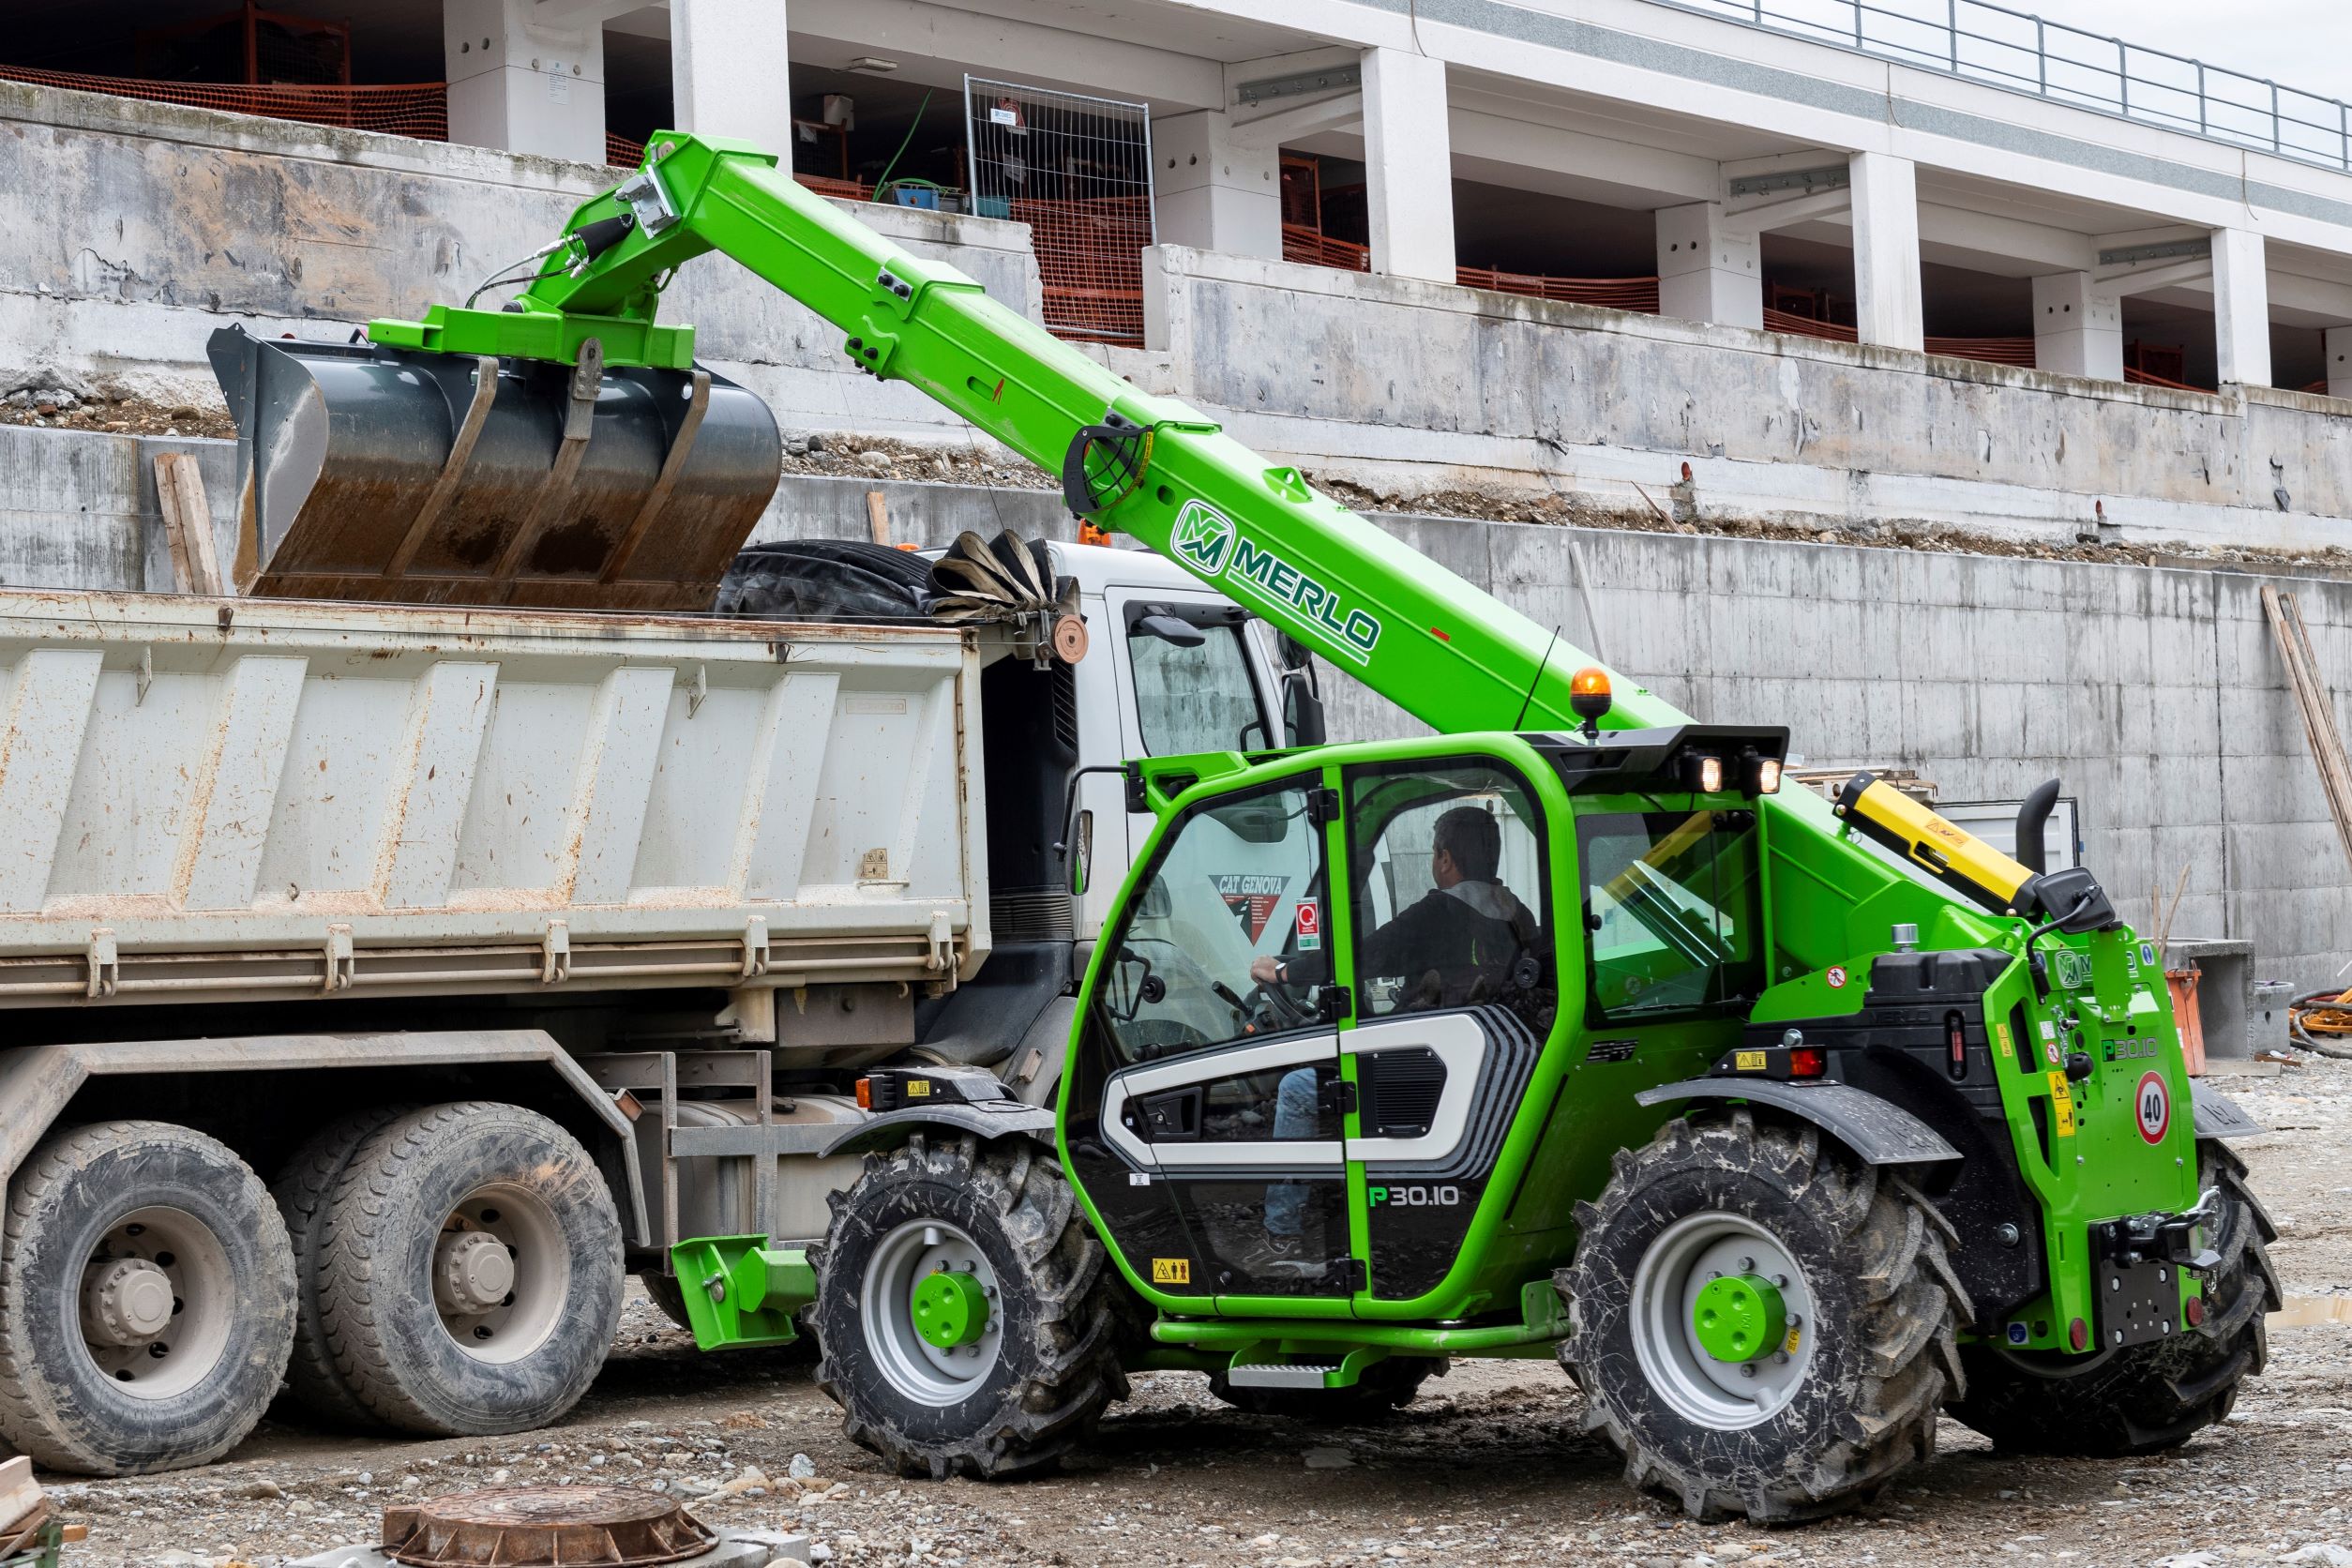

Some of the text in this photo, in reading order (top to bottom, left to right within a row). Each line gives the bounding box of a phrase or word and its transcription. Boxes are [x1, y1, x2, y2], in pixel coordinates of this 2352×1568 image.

[1231, 536, 1380, 651] MERLO
[1219, 875, 1282, 895] CAT GENOVA
[2101, 1037, 2158, 1062] P30.10
[2144, 1093, 2161, 1123] 40
[1369, 1185, 1459, 1207] P30.10
